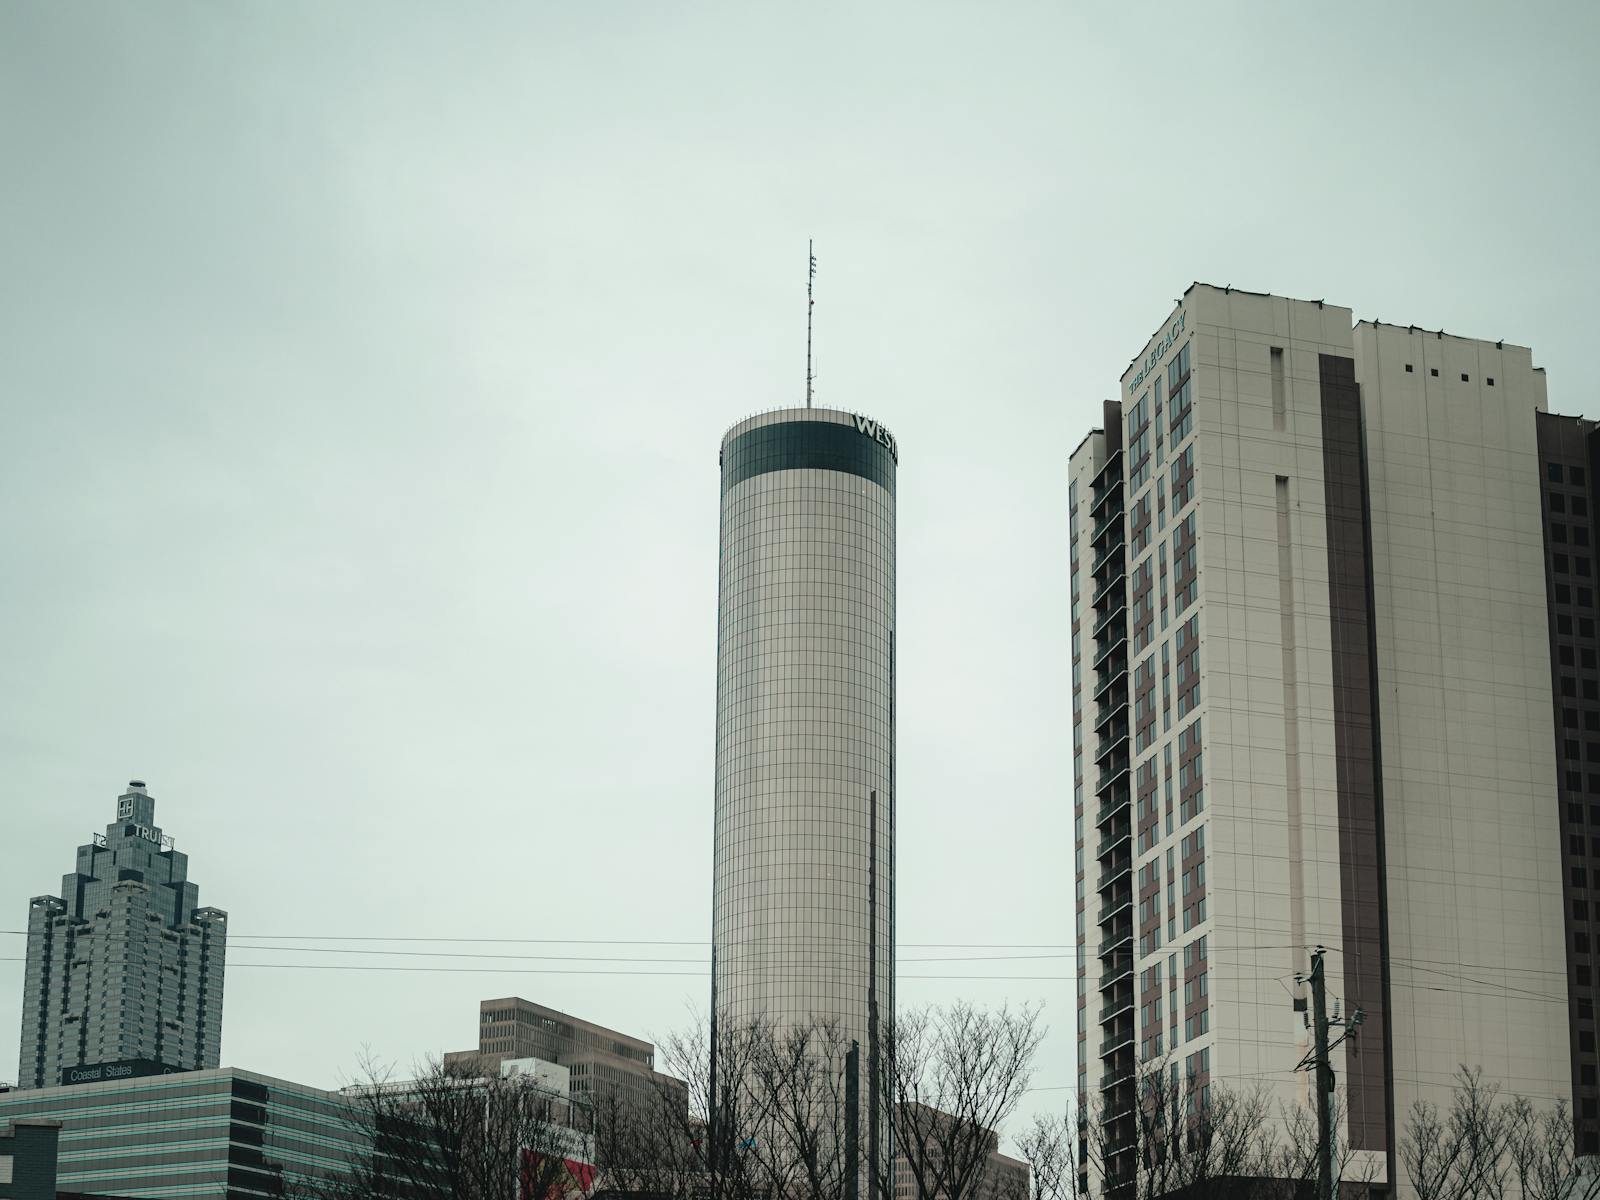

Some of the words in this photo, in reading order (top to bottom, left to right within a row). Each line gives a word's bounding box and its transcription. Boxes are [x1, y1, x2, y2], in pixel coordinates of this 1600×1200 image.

[1129, 371, 1144, 396] THE
[1145, 310, 1187, 378] LEGACY
[134, 823, 175, 849] TRUIST
[70, 1067, 102, 1082] Coastal
[105, 1065, 132, 1077] States
